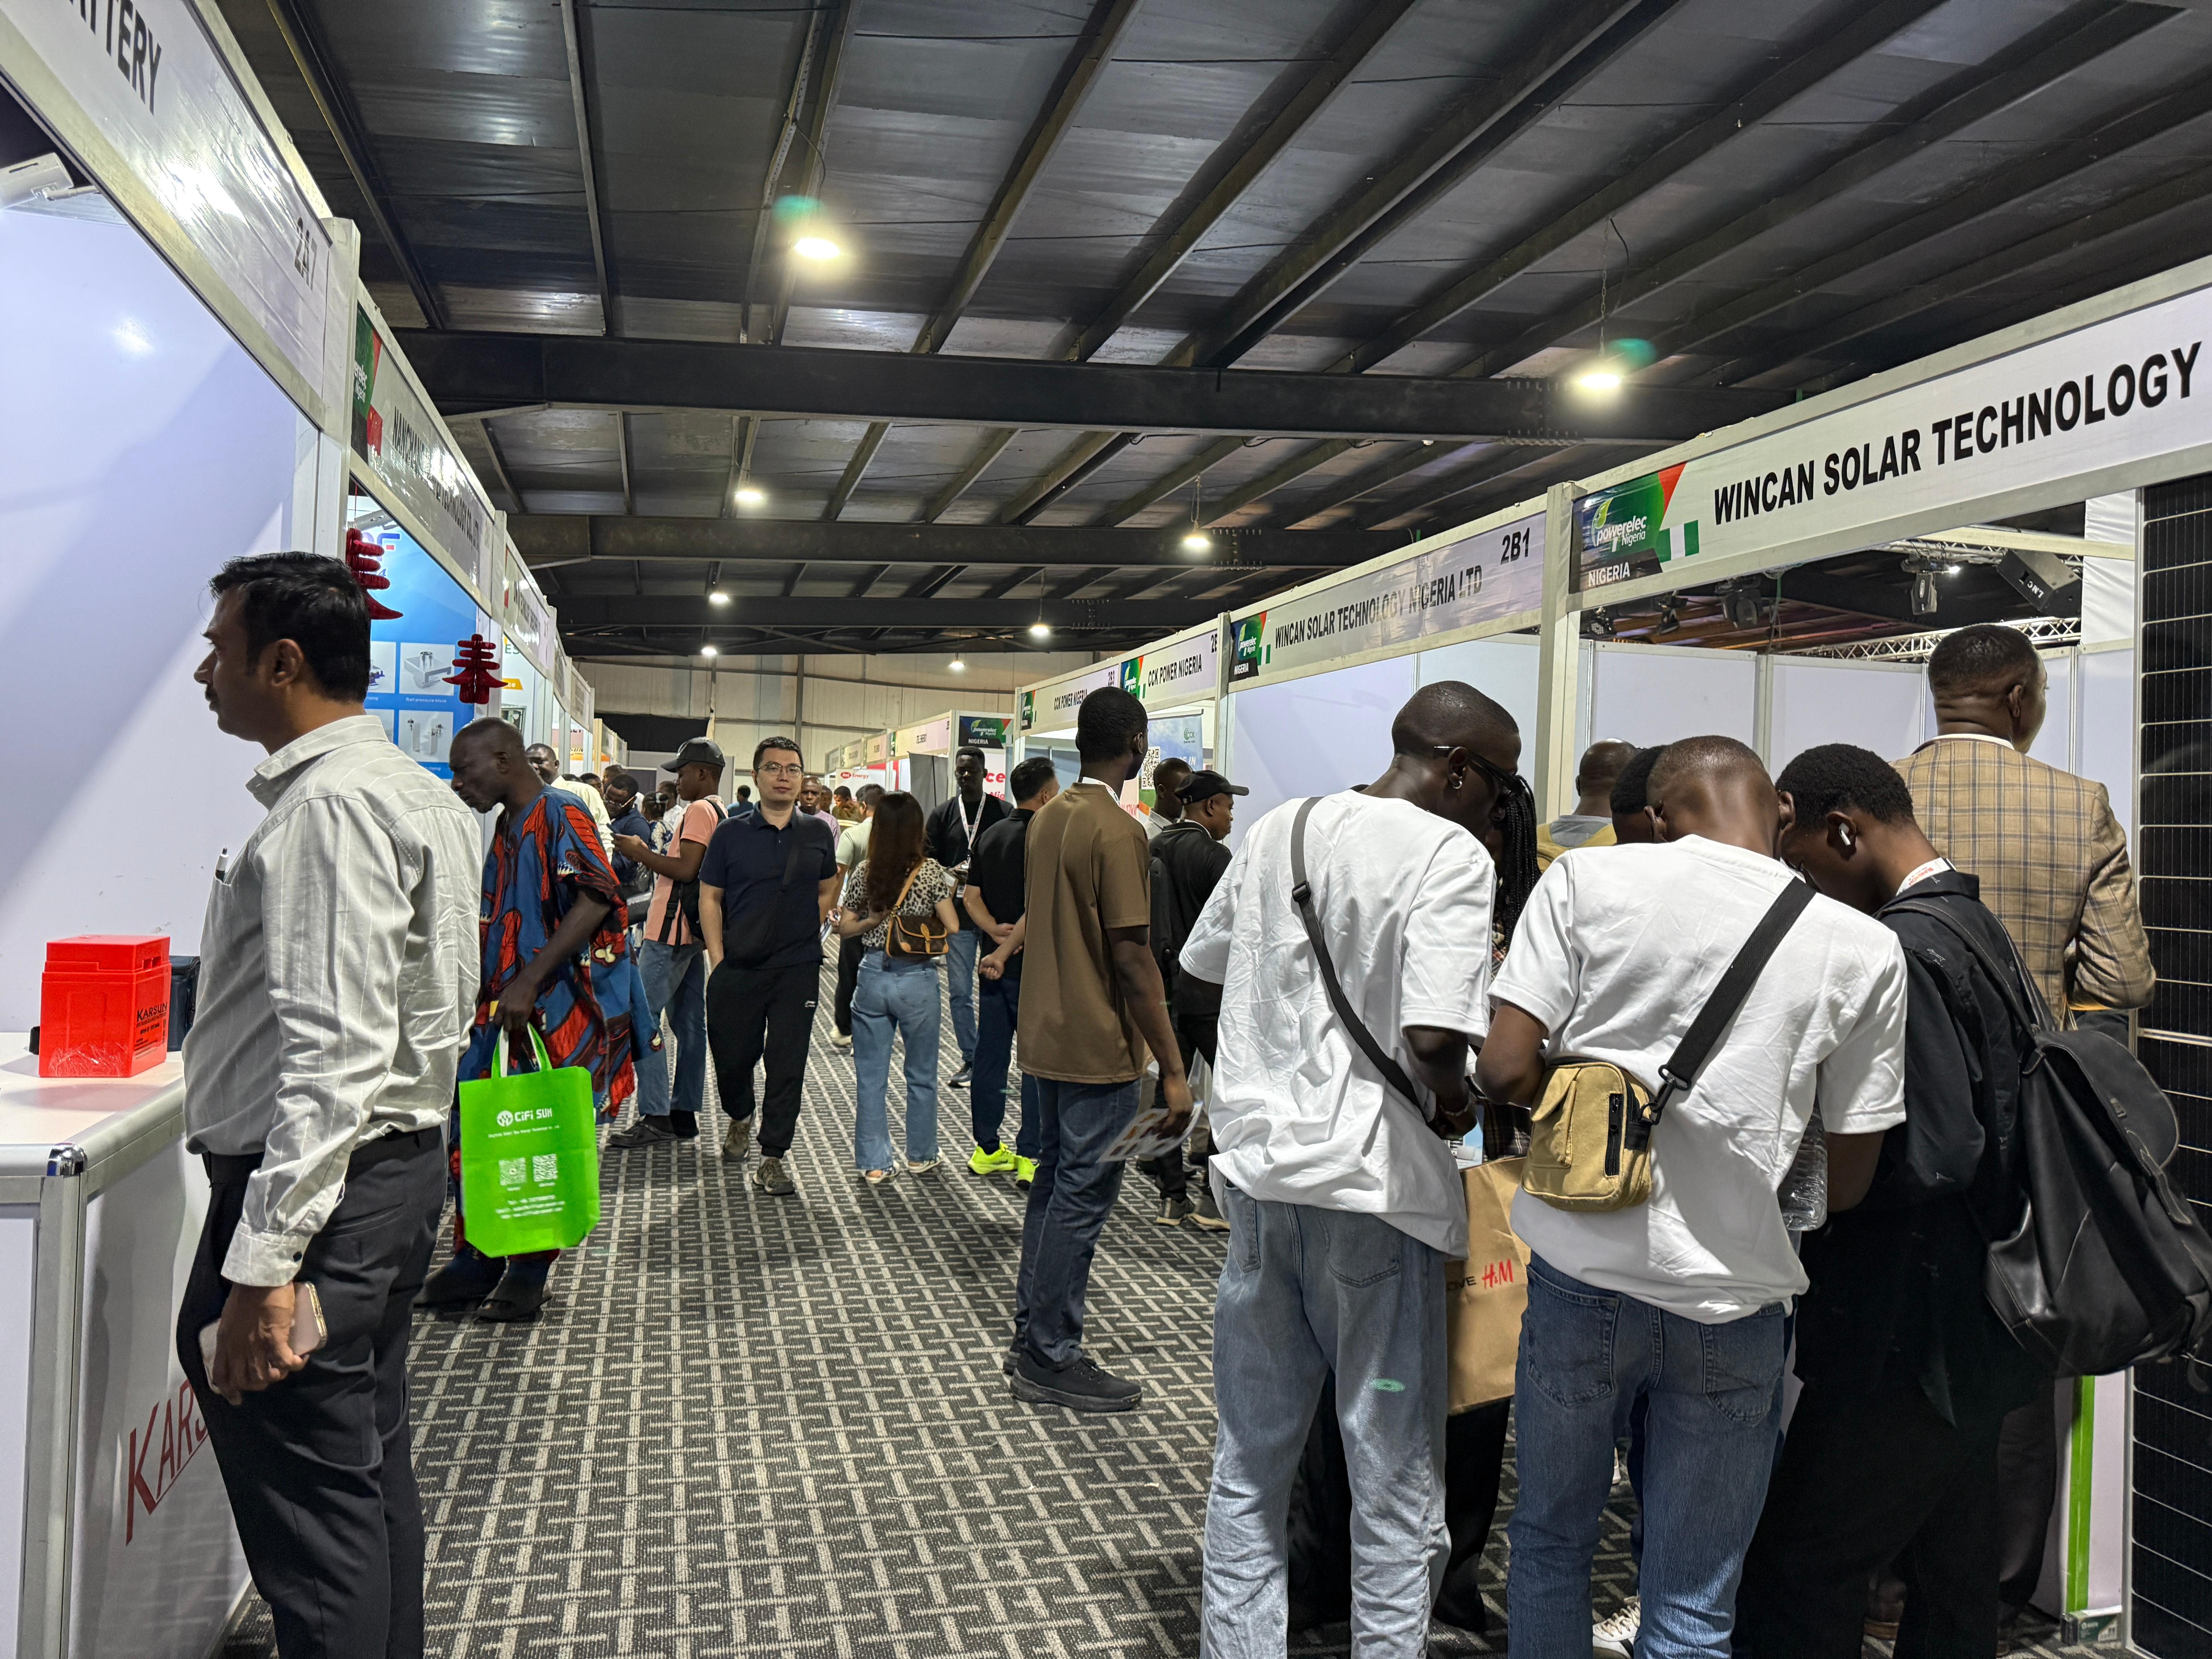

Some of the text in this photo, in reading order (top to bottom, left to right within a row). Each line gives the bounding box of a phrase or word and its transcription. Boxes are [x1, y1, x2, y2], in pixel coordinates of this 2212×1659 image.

[70, 0, 161, 116] TERY
[1715, 341, 2202, 525] WINCAN SOLAR TECHNOLOGY
[1596, 515, 1647, 546] powerelec
[1622, 529, 1645, 546] Nigeria
[1500, 527, 1530, 565] 2B1
[1588, 562, 1630, 587] NIGERIA
[1276, 565, 1482, 649] WINCAN SOLAR TECHNOLOGY NIGERIA LTD
[1148, 654, 1202, 687] CCK POWER NIGERIA
[1234, 662, 1249, 675] NIGERIA
[1061, 693, 1073, 708] POWER
[986, 773, 1006, 783] ce
[137, 1001, 167, 1022] KARSUN
[514, 1108, 552, 1122] CiFi SUN
[1447, 1258, 1513, 1291] OVE H&M
